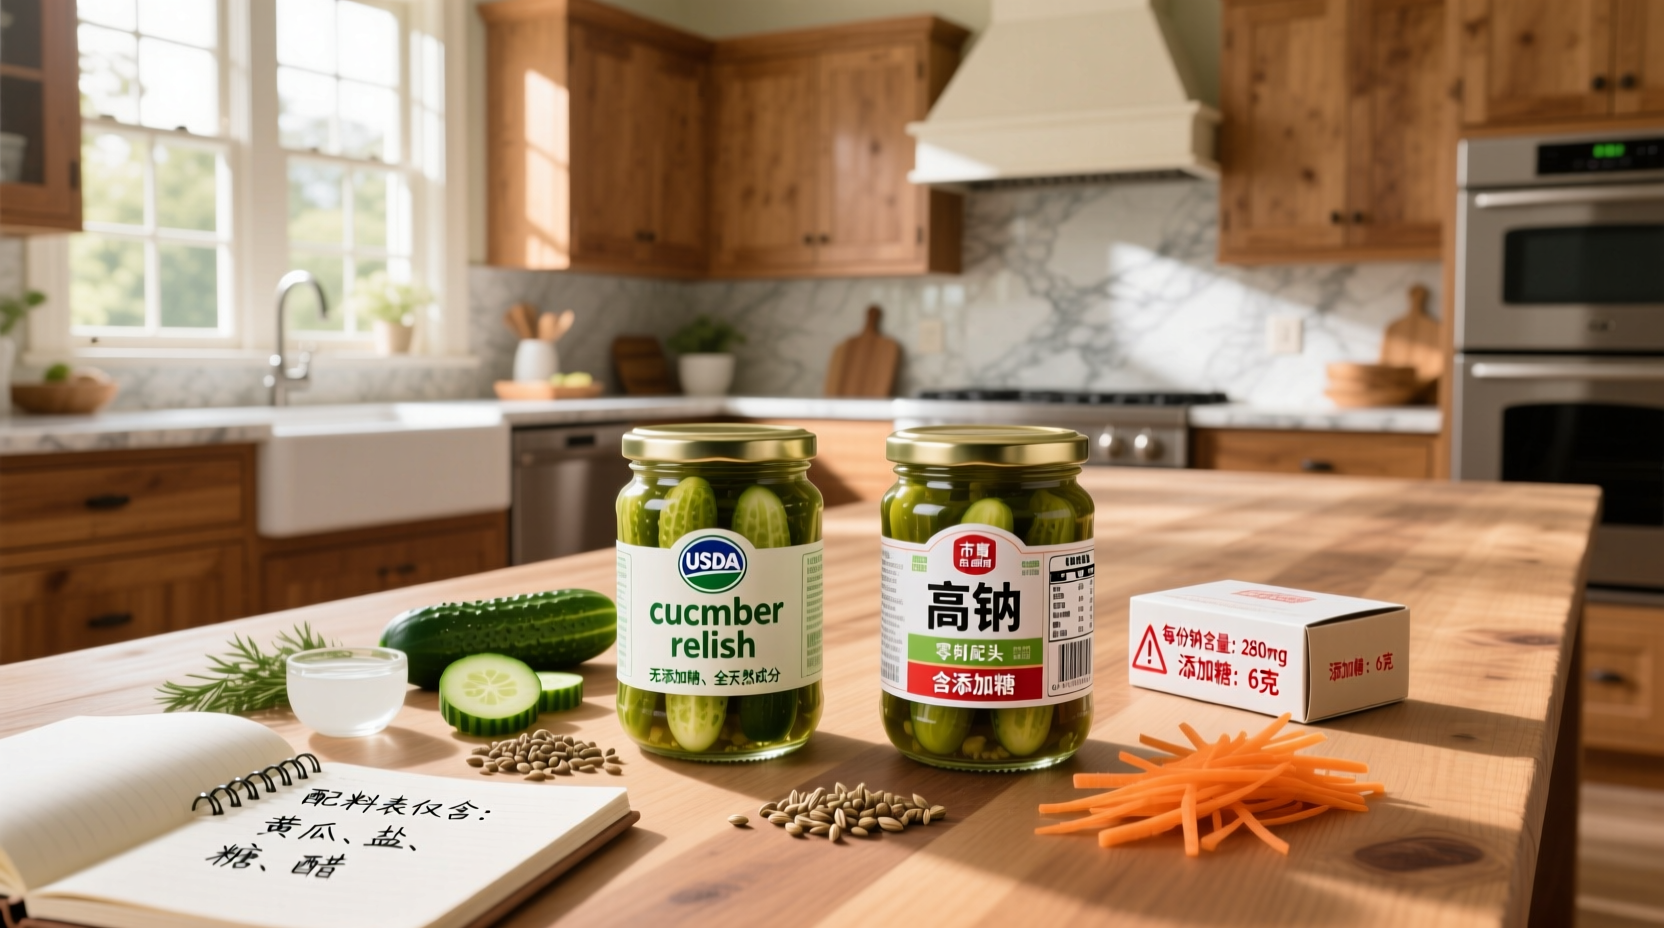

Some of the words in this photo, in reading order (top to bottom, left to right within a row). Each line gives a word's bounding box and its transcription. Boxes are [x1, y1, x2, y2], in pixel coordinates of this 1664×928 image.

[686, 552, 740, 571] USDA
[649, 597, 784, 626] cucmber
[927, 581, 1020, 632] 高钠
[671, 630, 756, 658] relish
[932, 671, 1016, 696] 含添加糖
